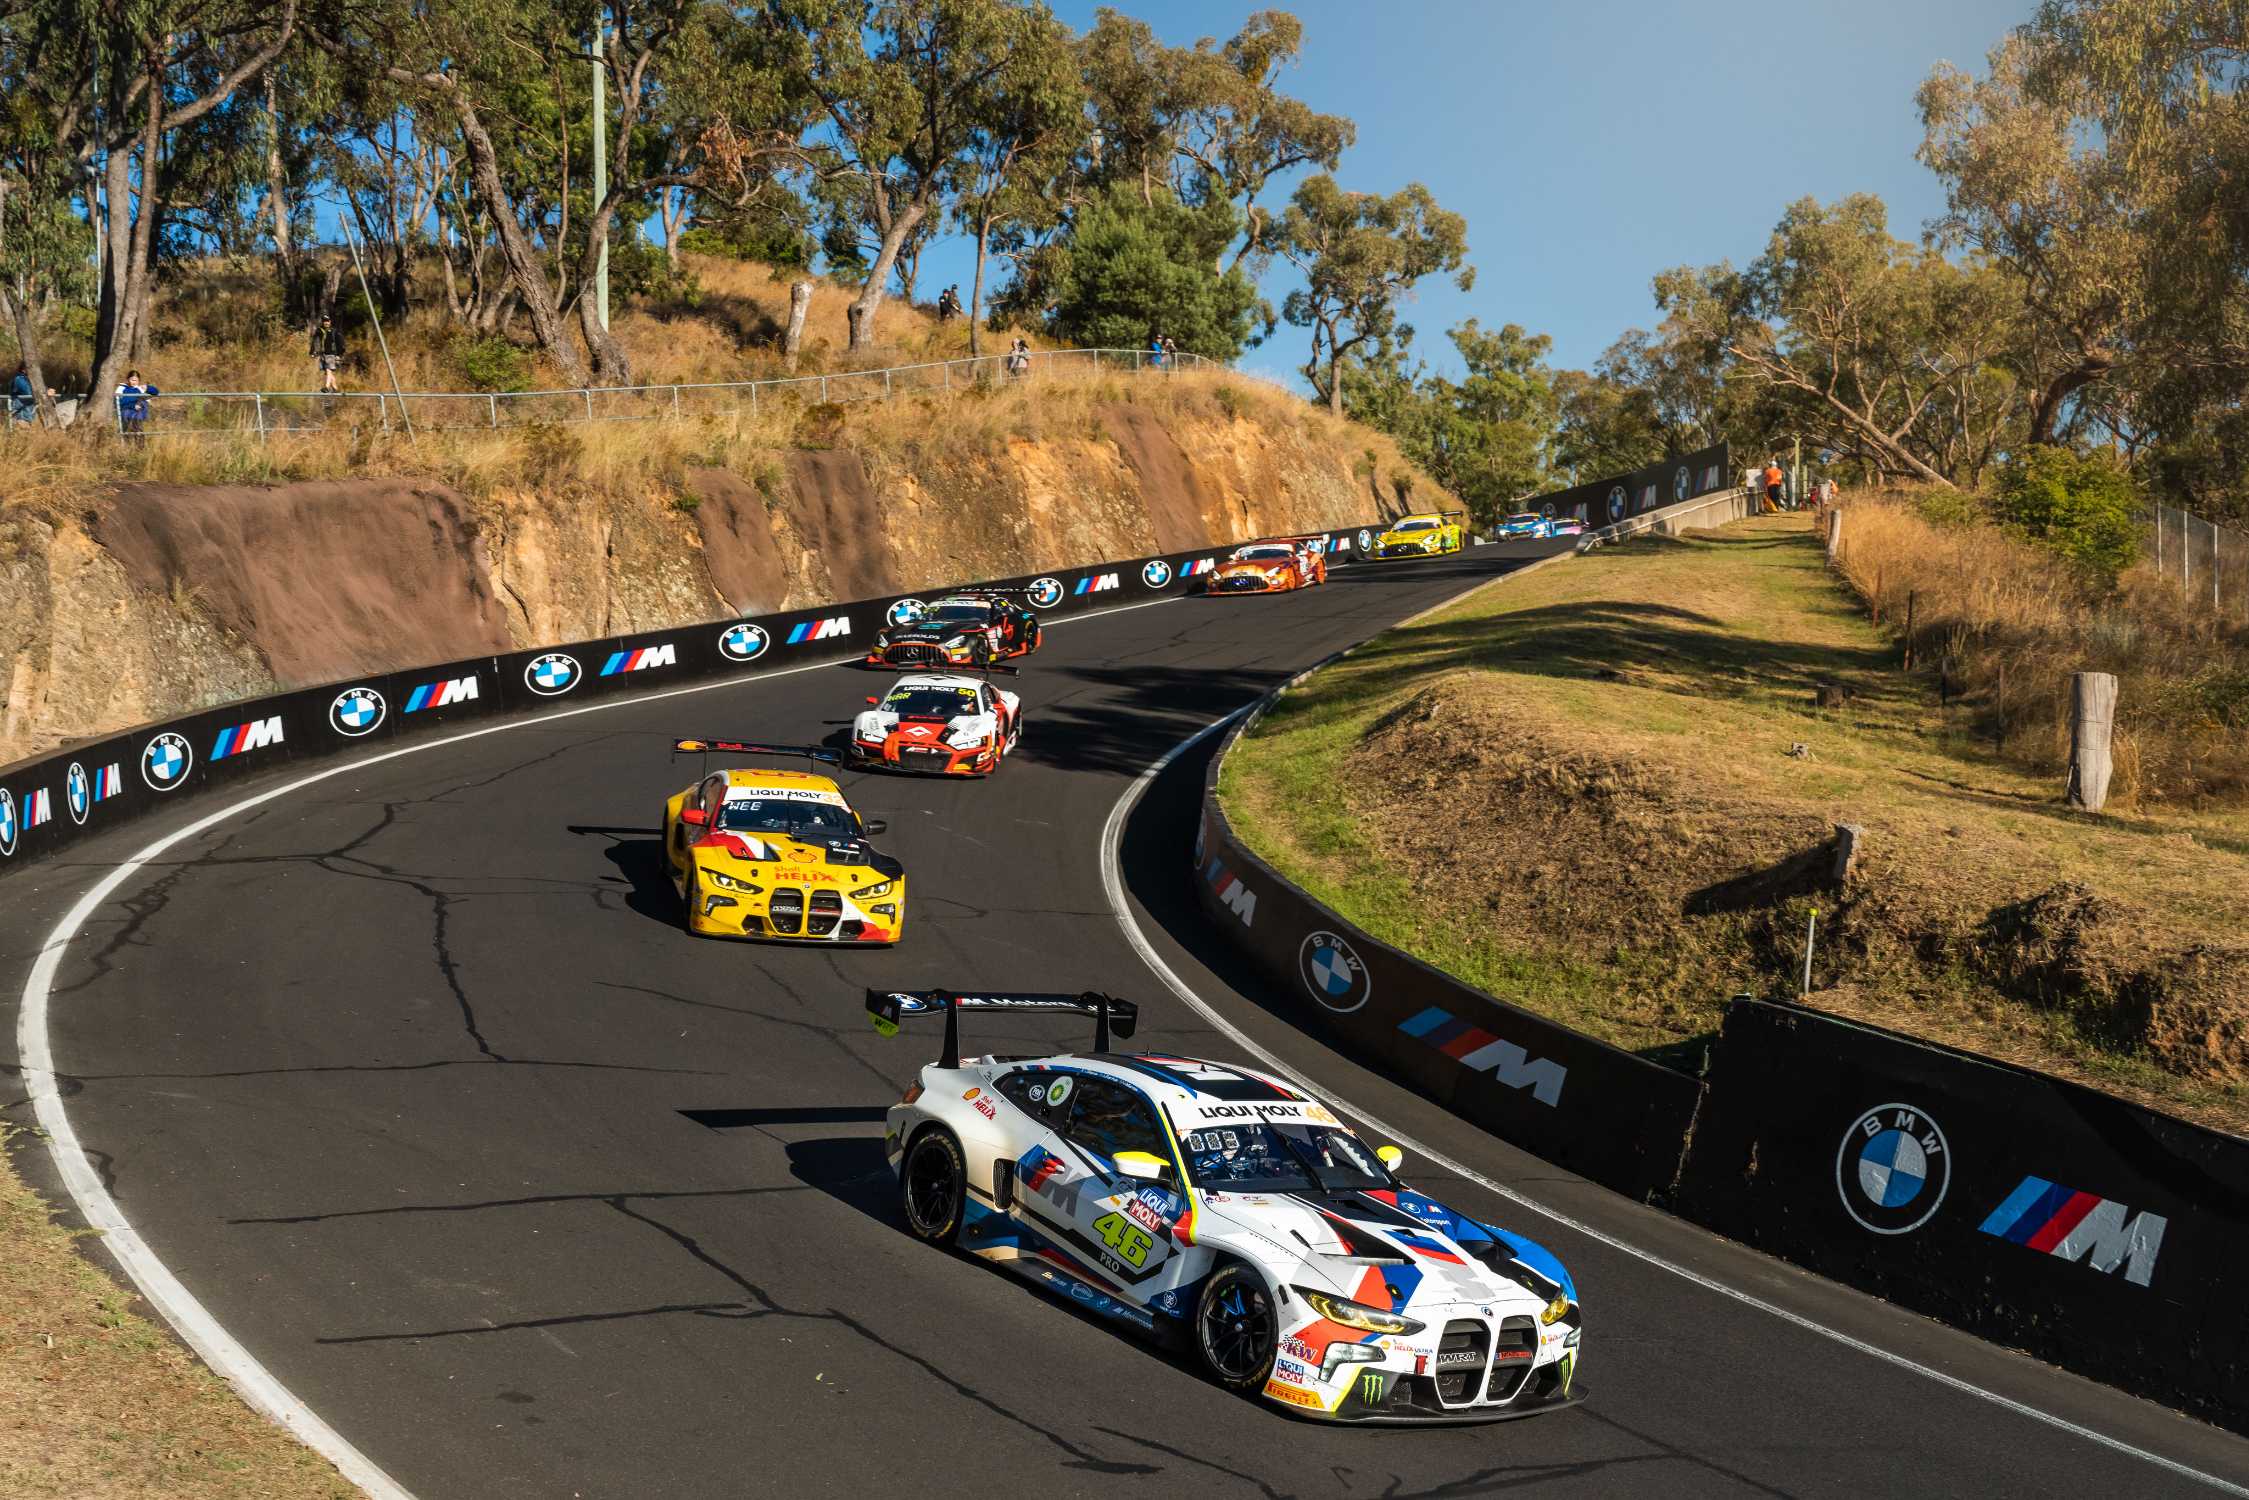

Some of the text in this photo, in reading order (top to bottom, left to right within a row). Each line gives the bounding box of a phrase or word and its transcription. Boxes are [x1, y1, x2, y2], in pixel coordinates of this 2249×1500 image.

[957, 688, 976, 698] 50
[750, 789, 784, 797] LIQUI
[788, 790, 822, 799] MOLY
[727, 801, 763, 811] WEE
[774, 870, 836, 882] HELIX
[1459, 1039, 1568, 1108] M
[972, 1101, 997, 1121] HELIX
[1198, 1105, 1338, 1123] LIQUI MOLY 46
[1138, 1186, 1170, 1217] LIQUI
[1129, 1199, 1162, 1232] MOLY
[1092, 1211, 1155, 1269] 46
[2049, 1198, 2169, 1287] M
[1099, 1252, 1121, 1273] PRO
[1279, 1359, 1304, 1374] LIQUI
[1439, 1352, 1476, 1364] WRT
[1278, 1368, 1303, 1384] MOLY
